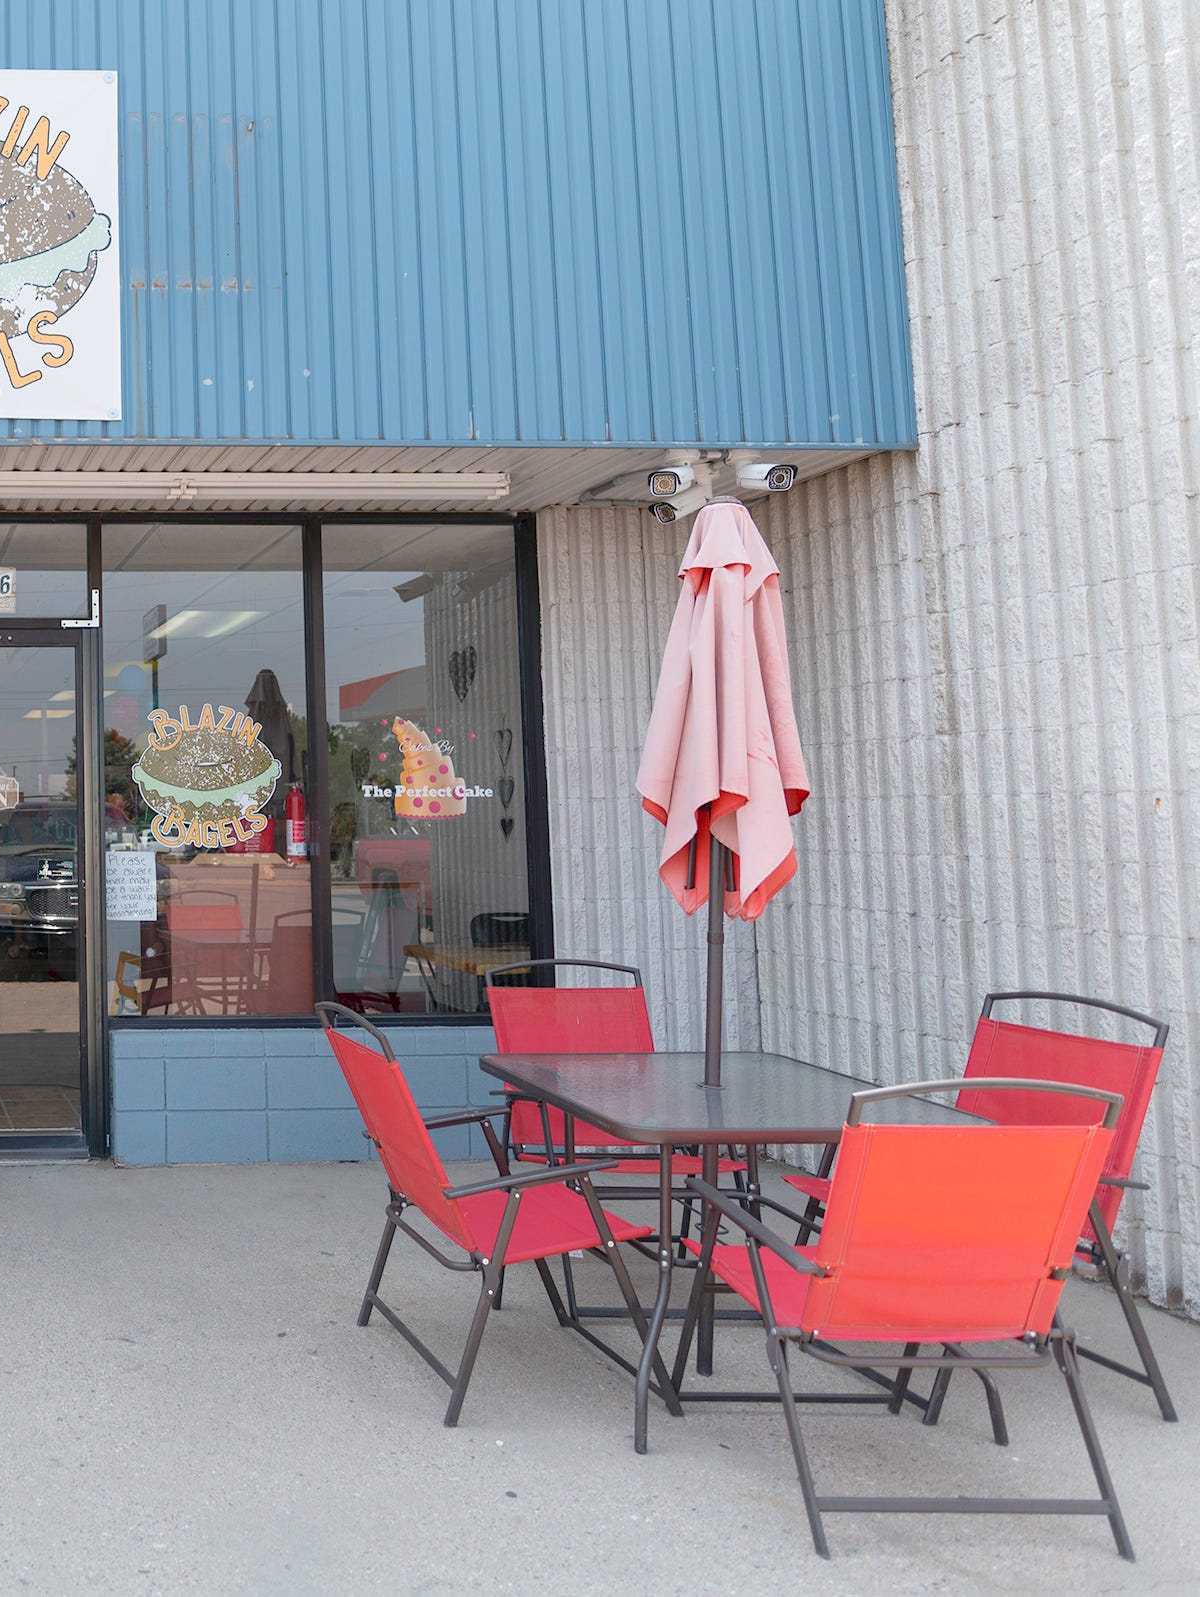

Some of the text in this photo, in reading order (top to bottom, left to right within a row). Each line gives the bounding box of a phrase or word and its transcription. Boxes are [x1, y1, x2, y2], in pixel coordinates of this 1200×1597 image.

[148, 703, 262, 751] BLAZIN
[398, 739, 455, 754] Cakes By
[362, 785, 494, 797] The Perfect Cake
[151, 804, 268, 848] BAGELS
[108, 854, 146, 866] Please
